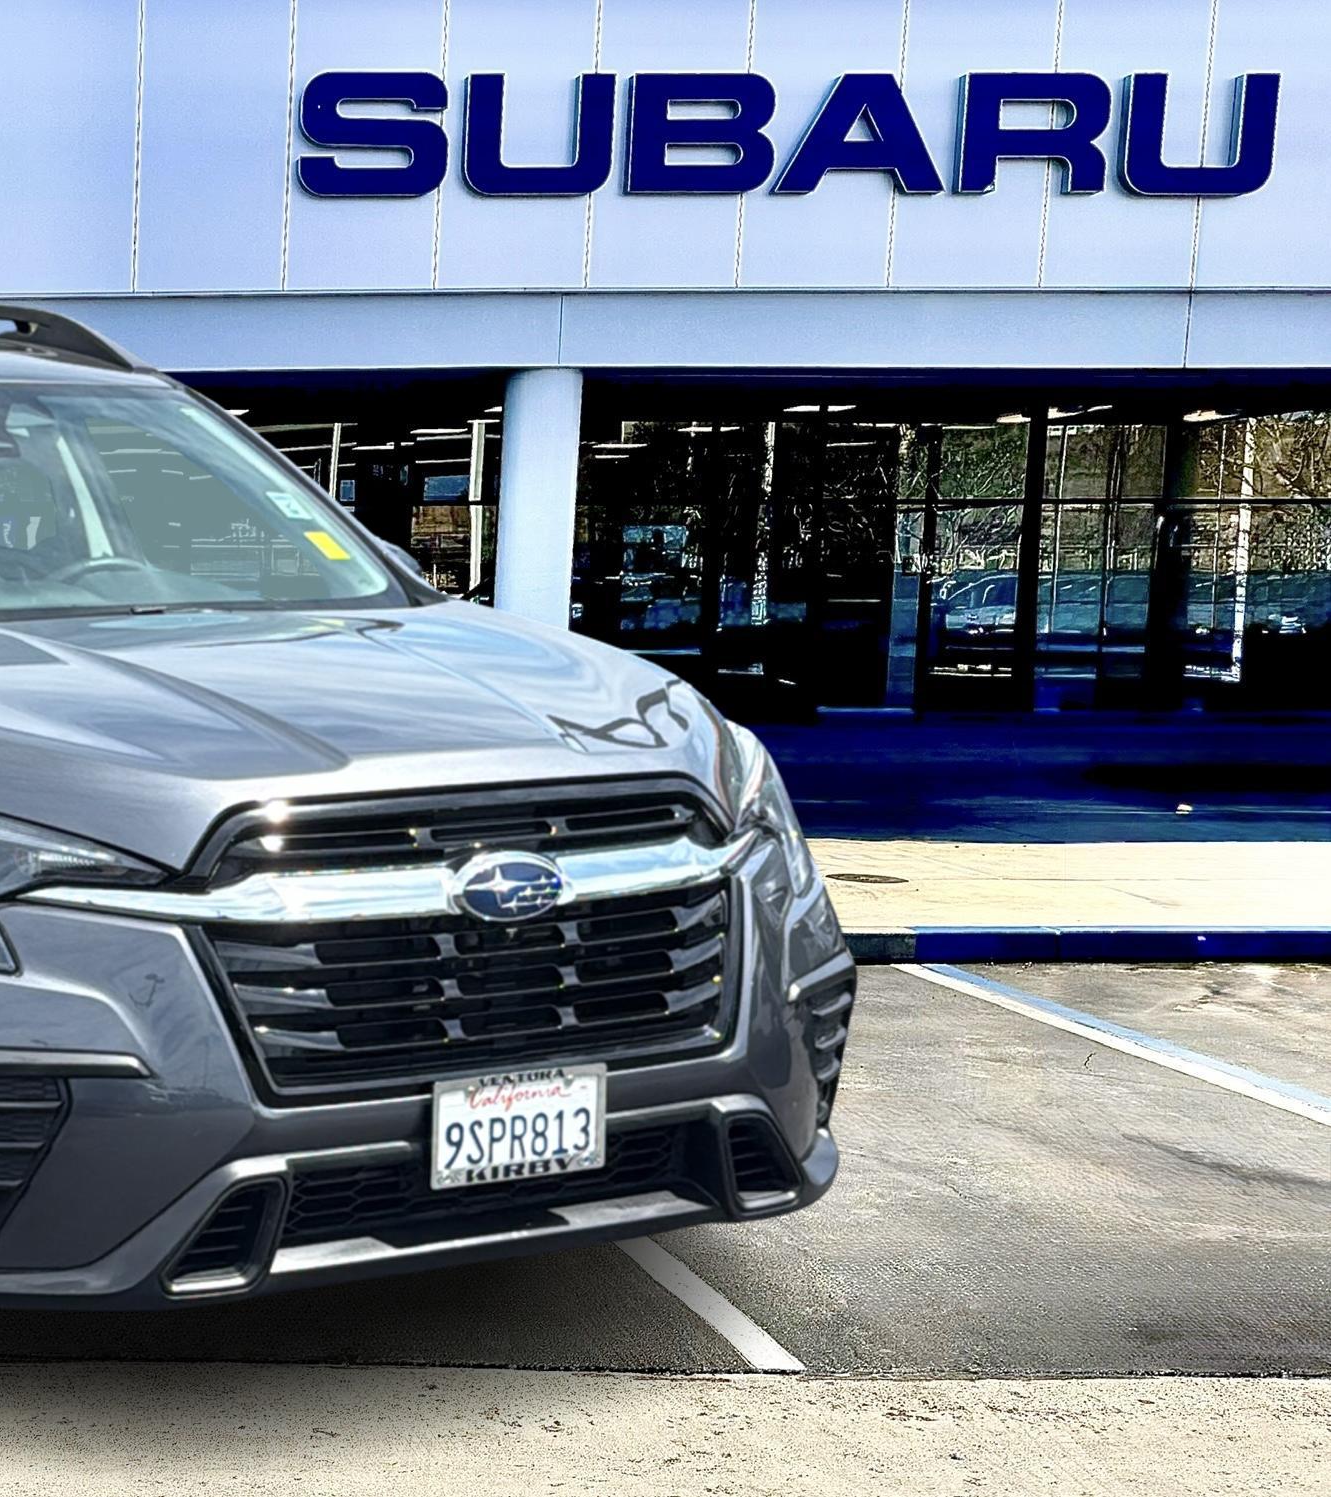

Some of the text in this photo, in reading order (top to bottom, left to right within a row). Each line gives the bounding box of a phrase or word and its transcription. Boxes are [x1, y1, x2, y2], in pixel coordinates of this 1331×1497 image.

[297, 70, 1281, 197] SUBARU
[479, 1068, 565, 1087] VENTURA
[468, 1085, 571, 1111] California
[445, 1107, 591, 1169] 9SPR813
[467, 1157, 573, 1183] KIRBY
